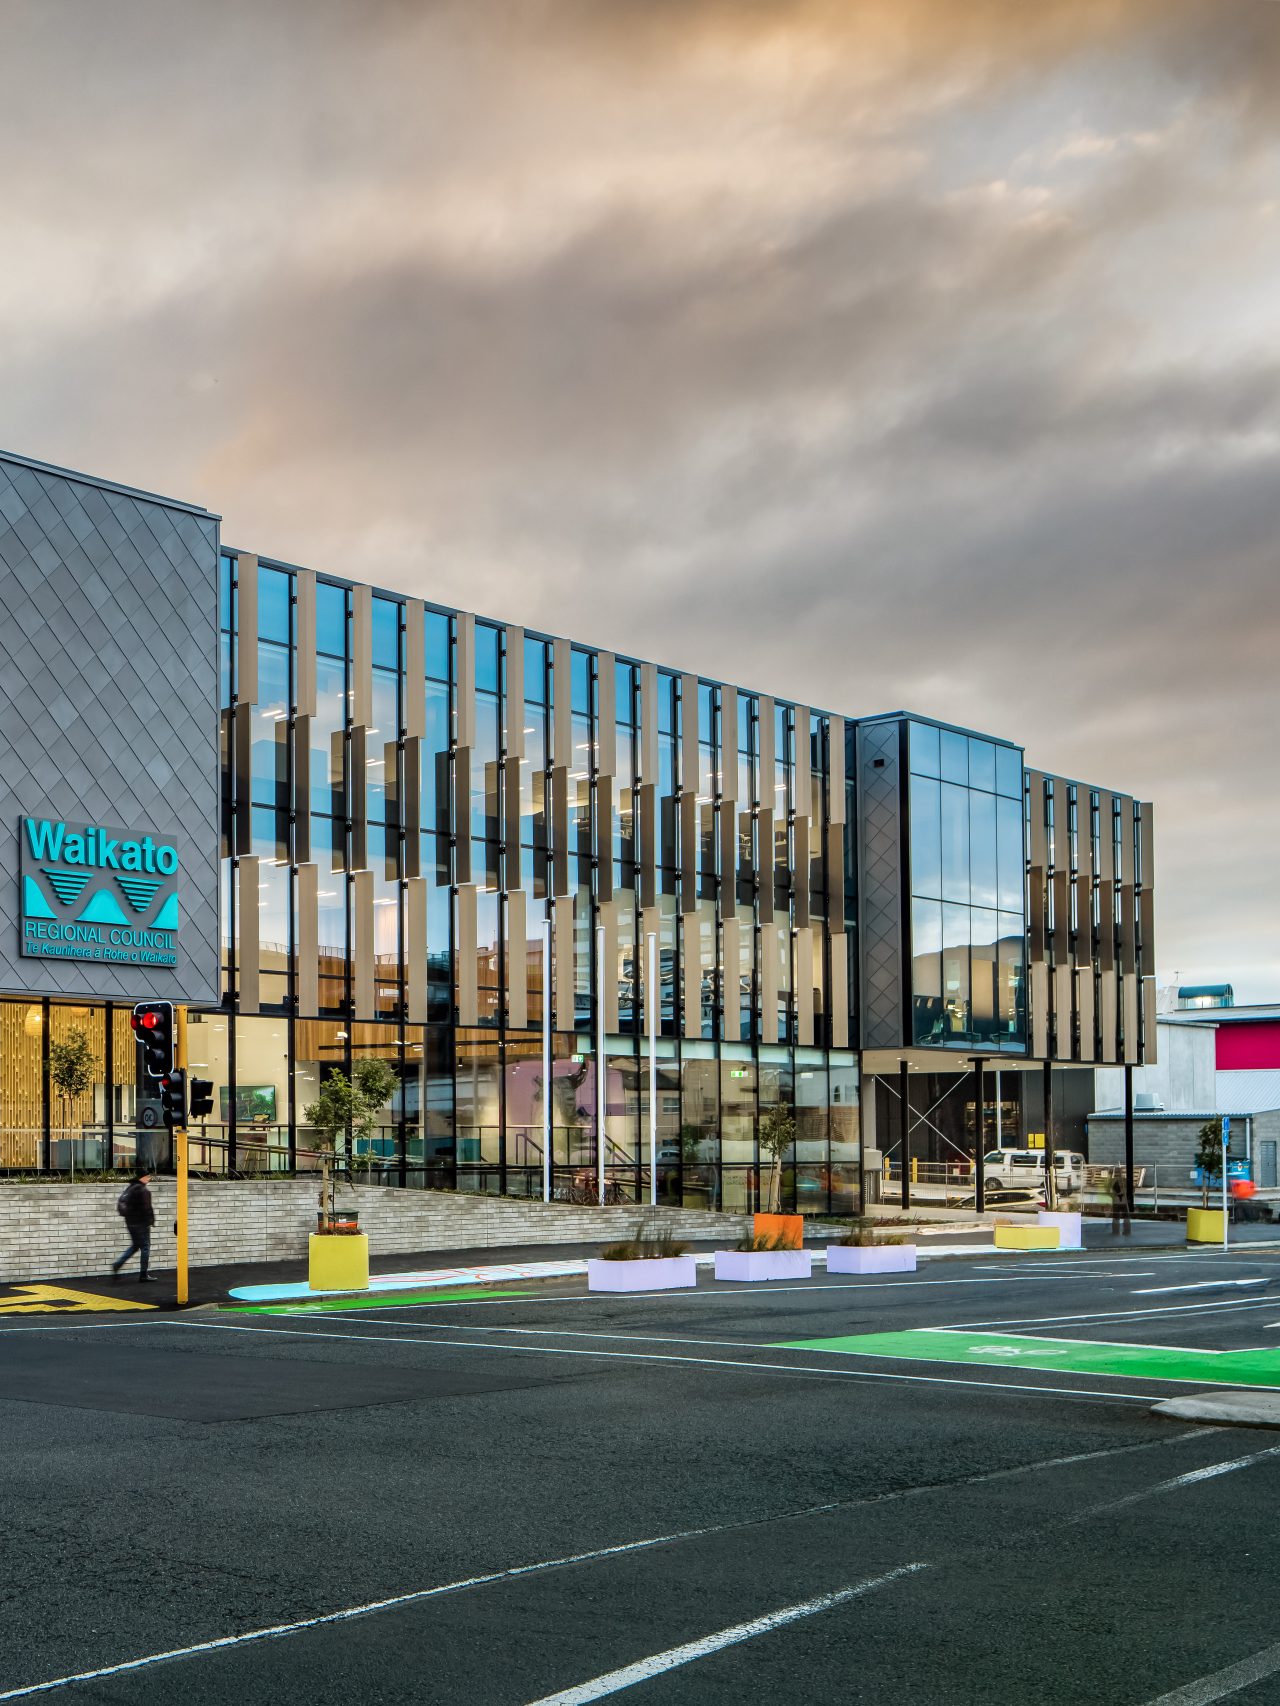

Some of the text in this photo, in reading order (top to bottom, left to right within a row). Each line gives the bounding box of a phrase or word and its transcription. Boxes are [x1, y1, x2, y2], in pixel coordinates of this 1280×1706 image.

[25, 818, 178, 875] Waikato
[25, 921, 176, 949] REGIONAL COUNCIL
[26, 941, 177, 964] Te Kaunihera ā Rohe o Waikato
